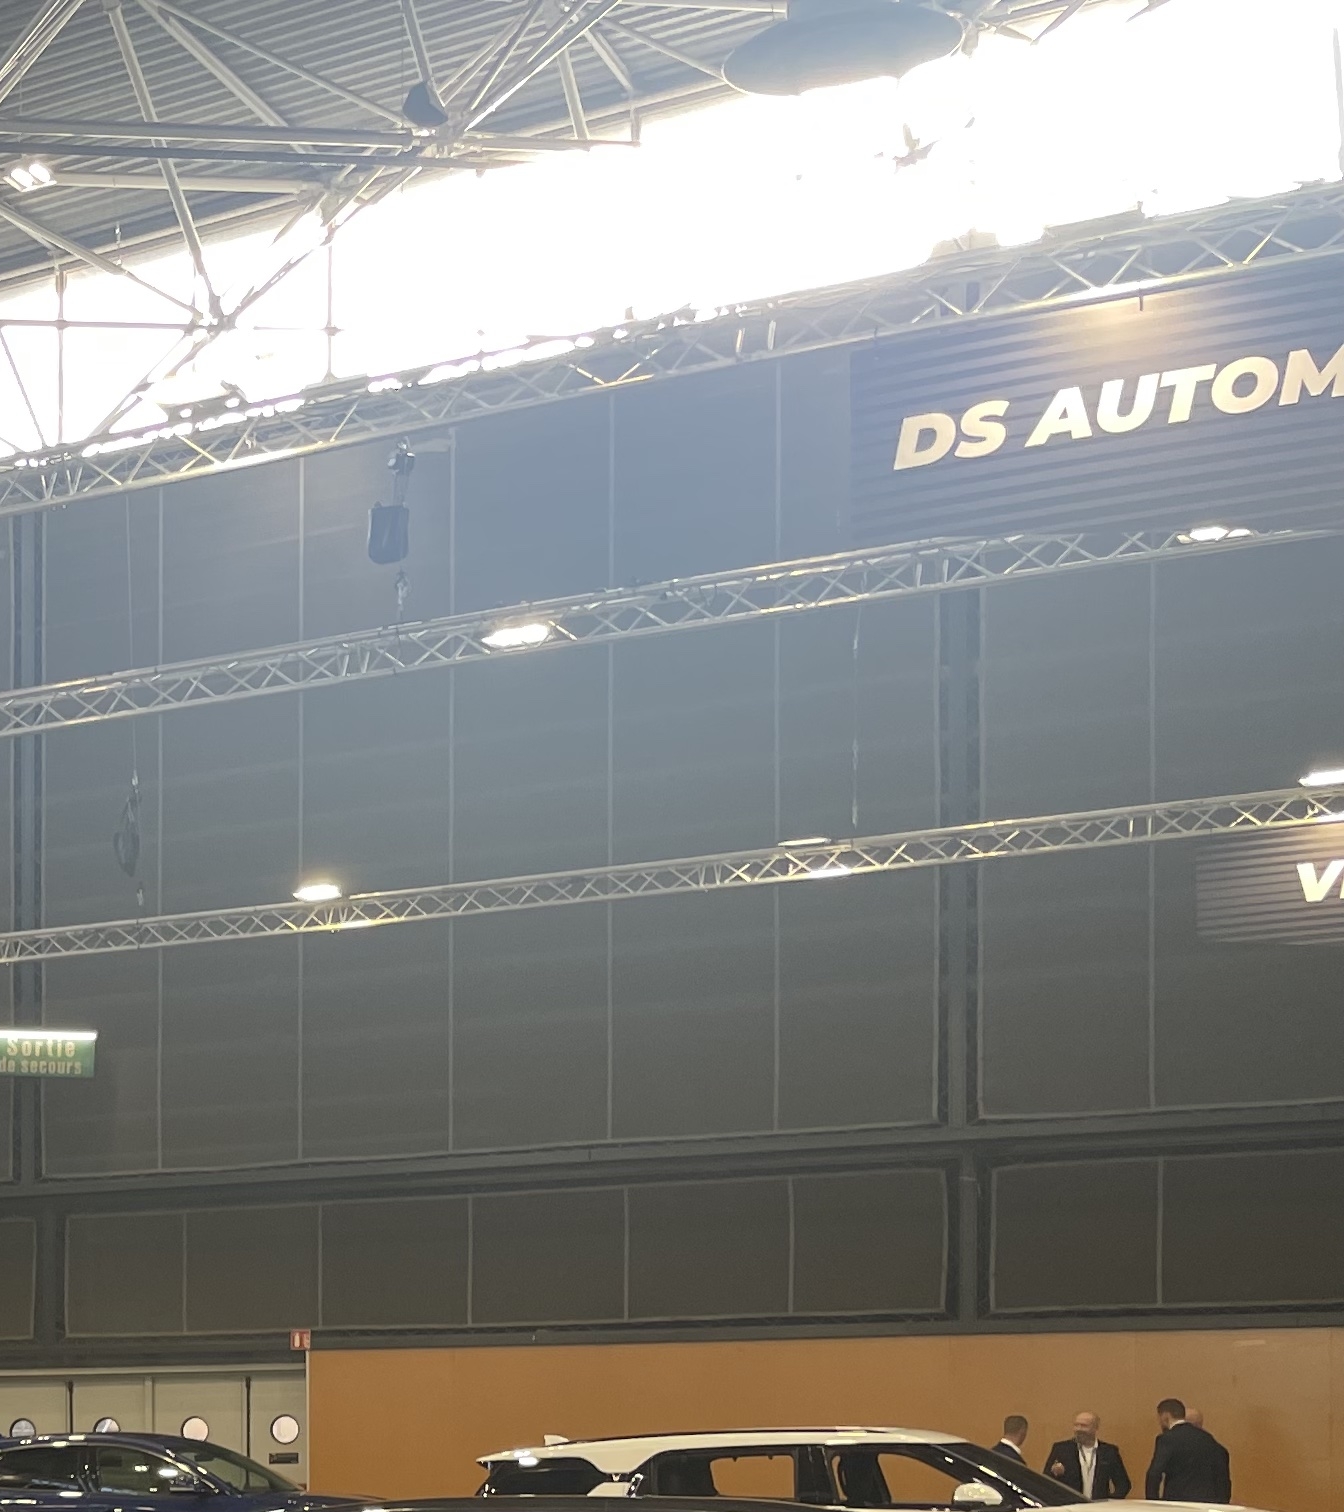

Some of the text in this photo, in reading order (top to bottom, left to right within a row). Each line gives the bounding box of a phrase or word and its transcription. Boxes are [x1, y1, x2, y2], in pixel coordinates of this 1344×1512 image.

[893, 343, 1344, 471] DS AUTOM
[1296, 859, 1344, 903] V
[6, 1038, 76, 1057] Sortie
[21, 1061, 82, 1075] secours
